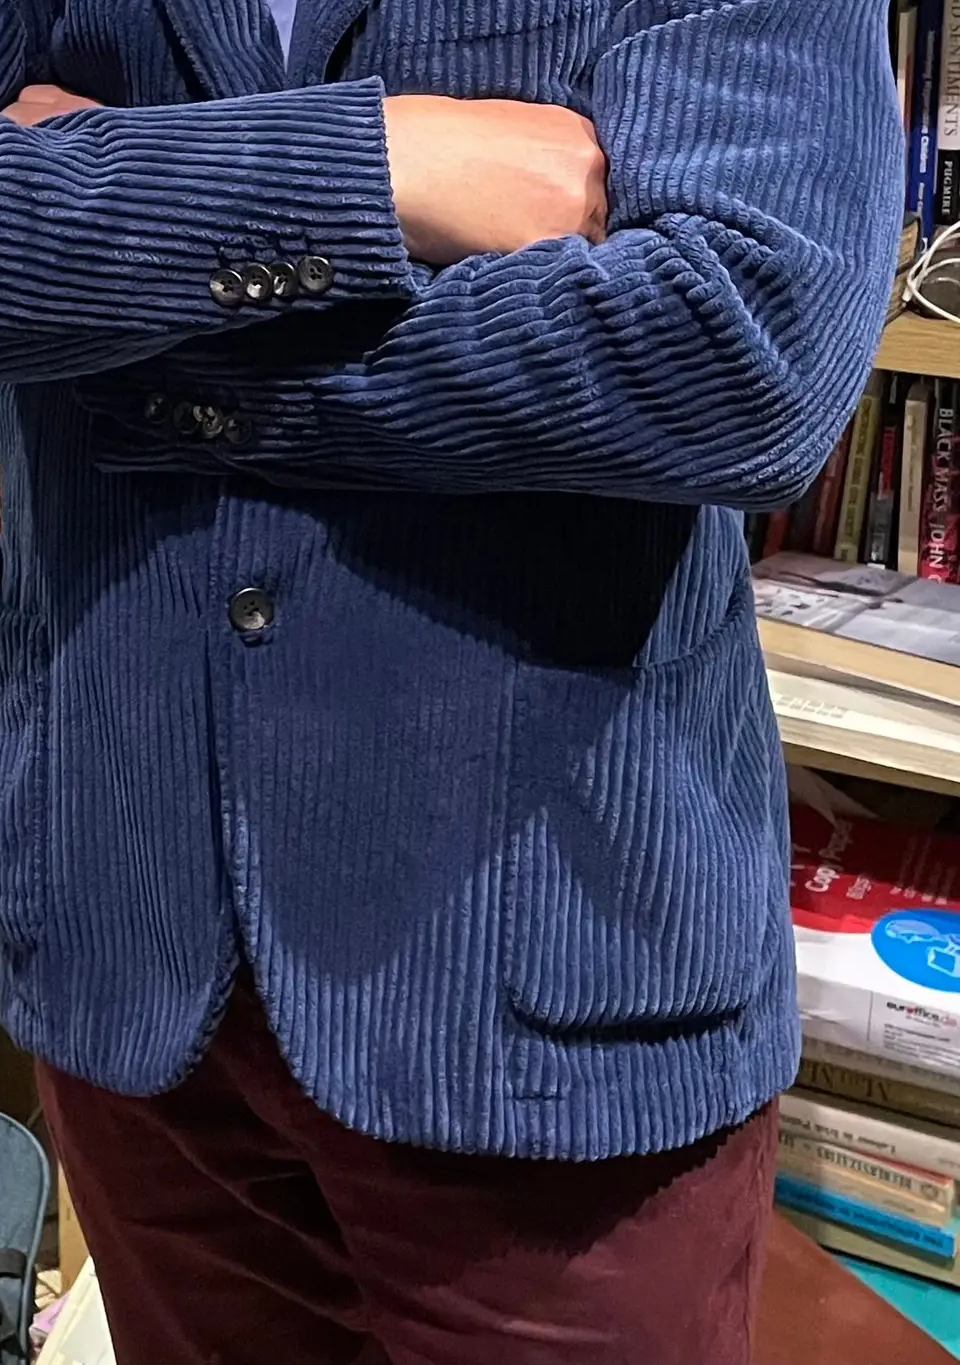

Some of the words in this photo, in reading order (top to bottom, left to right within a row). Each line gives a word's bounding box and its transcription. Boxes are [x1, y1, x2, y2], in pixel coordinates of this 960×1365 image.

[943, 23, 960, 138] SENTIMENTS
[919, 136, 930, 174] Children
[940, 159, 954, 215] PUGMIRE
[936, 408, 954, 461] BLACK
[932, 468, 949, 512] MASS
[928, 523, 945, 568] JOHN
